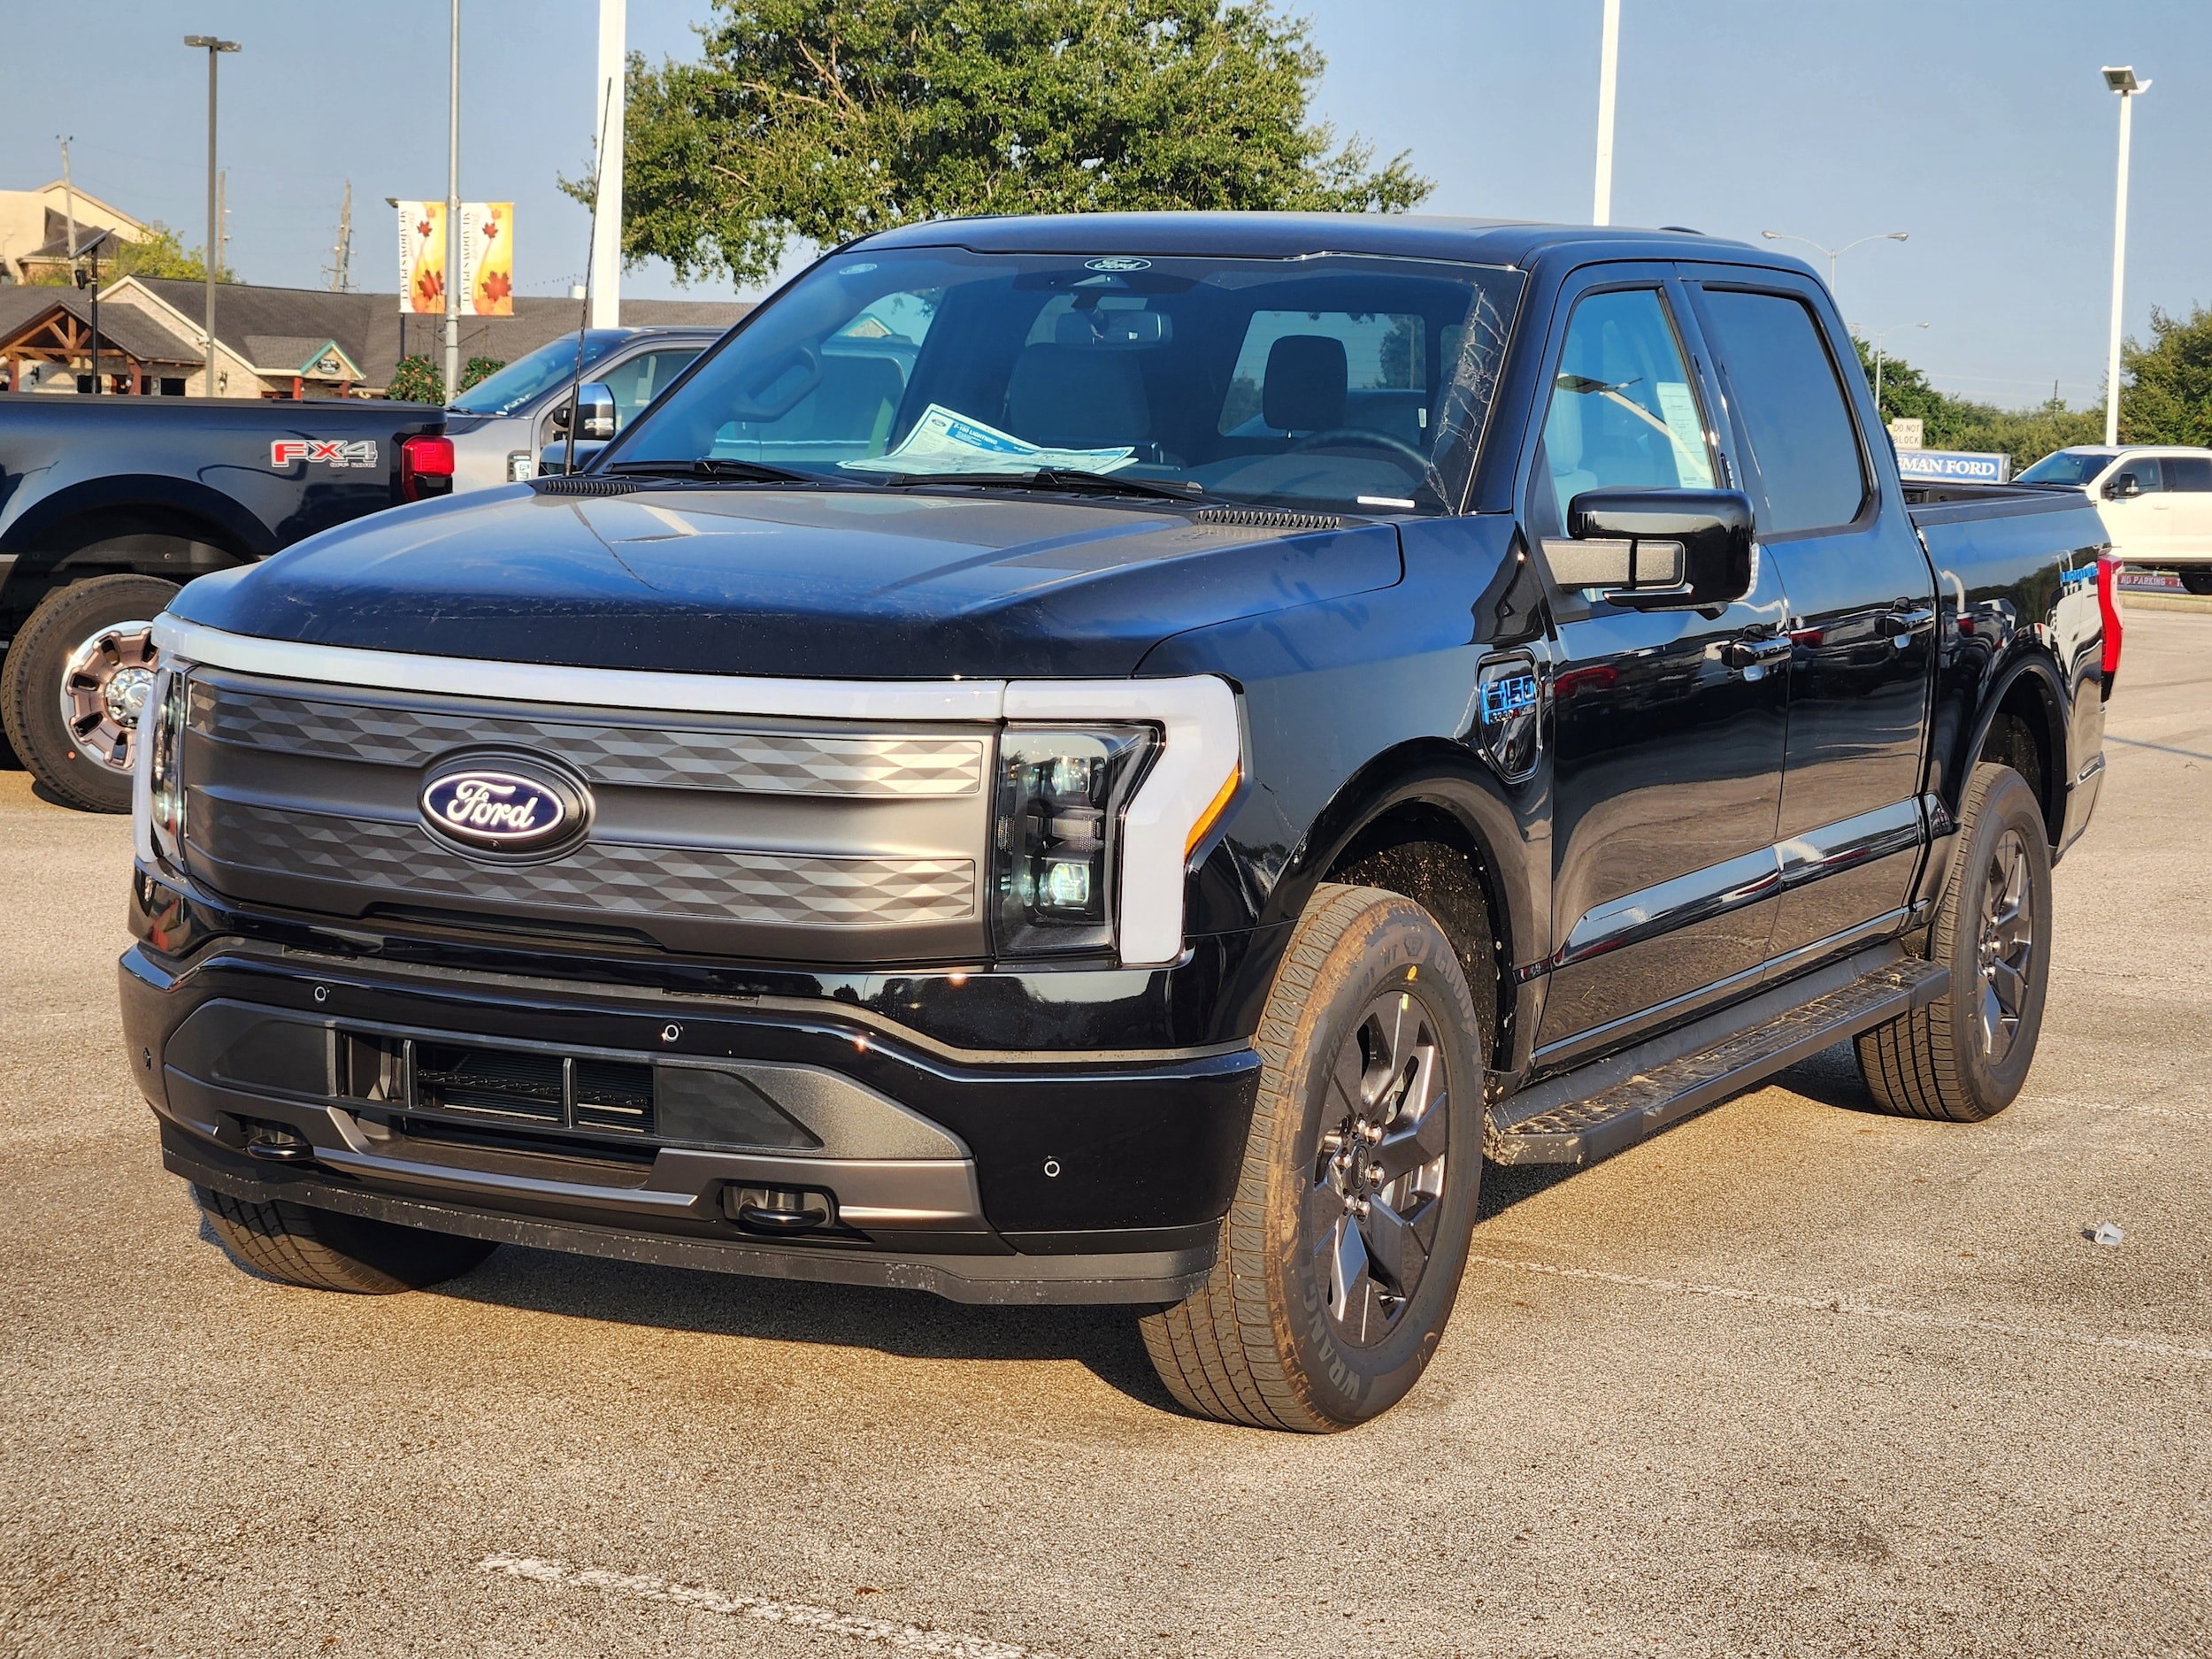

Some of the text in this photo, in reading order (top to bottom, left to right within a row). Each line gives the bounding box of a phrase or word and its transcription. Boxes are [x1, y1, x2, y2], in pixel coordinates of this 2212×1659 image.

[1094, 257, 1141, 269] Ford
[1893, 435, 1919, 444] BLOCK
[271, 440, 378, 467] FX4
[1946, 460, 1996, 476] FORD
[2120, 575, 2131, 584] NO
[2133, 576, 2166, 587] PARKING
[446, 780, 538, 828] Ford
